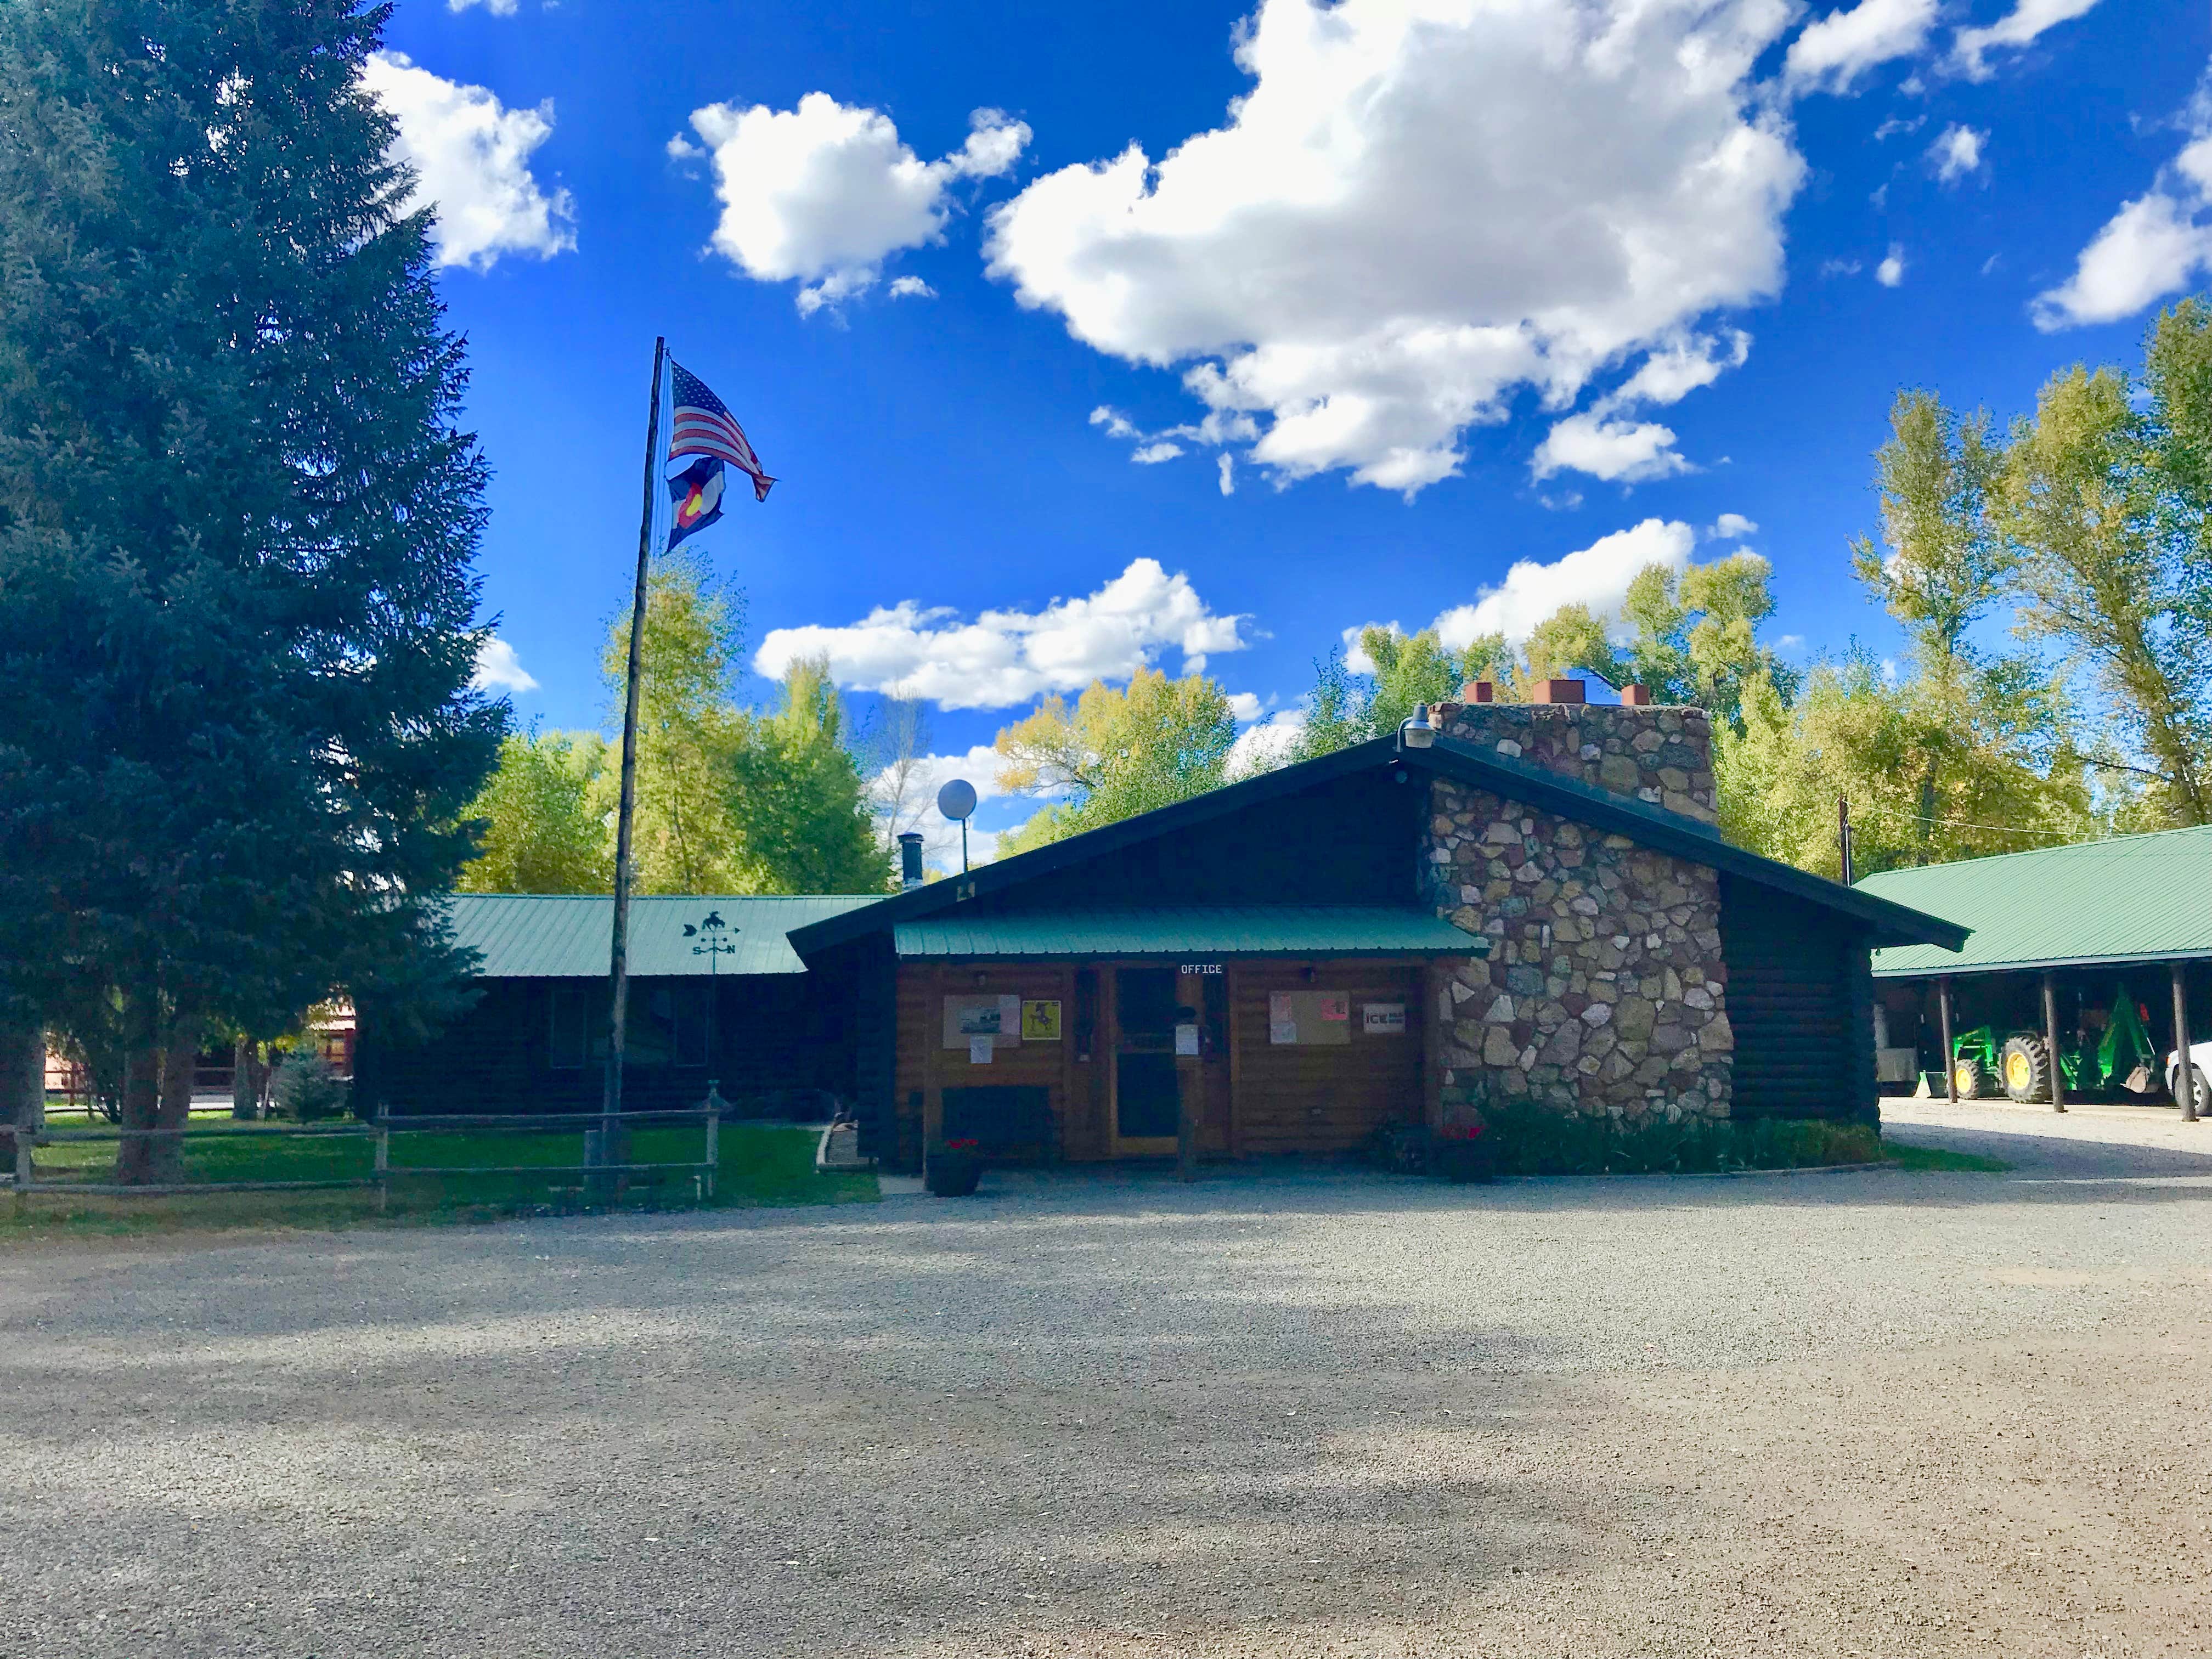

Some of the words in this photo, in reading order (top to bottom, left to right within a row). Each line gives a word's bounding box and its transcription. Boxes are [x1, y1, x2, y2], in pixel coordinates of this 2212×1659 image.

[693, 946, 701, 955] S
[727, 945, 735, 953] N
[1181, 964, 1222, 974] OFFICE
[1366, 1013, 1387, 1024] ICE
